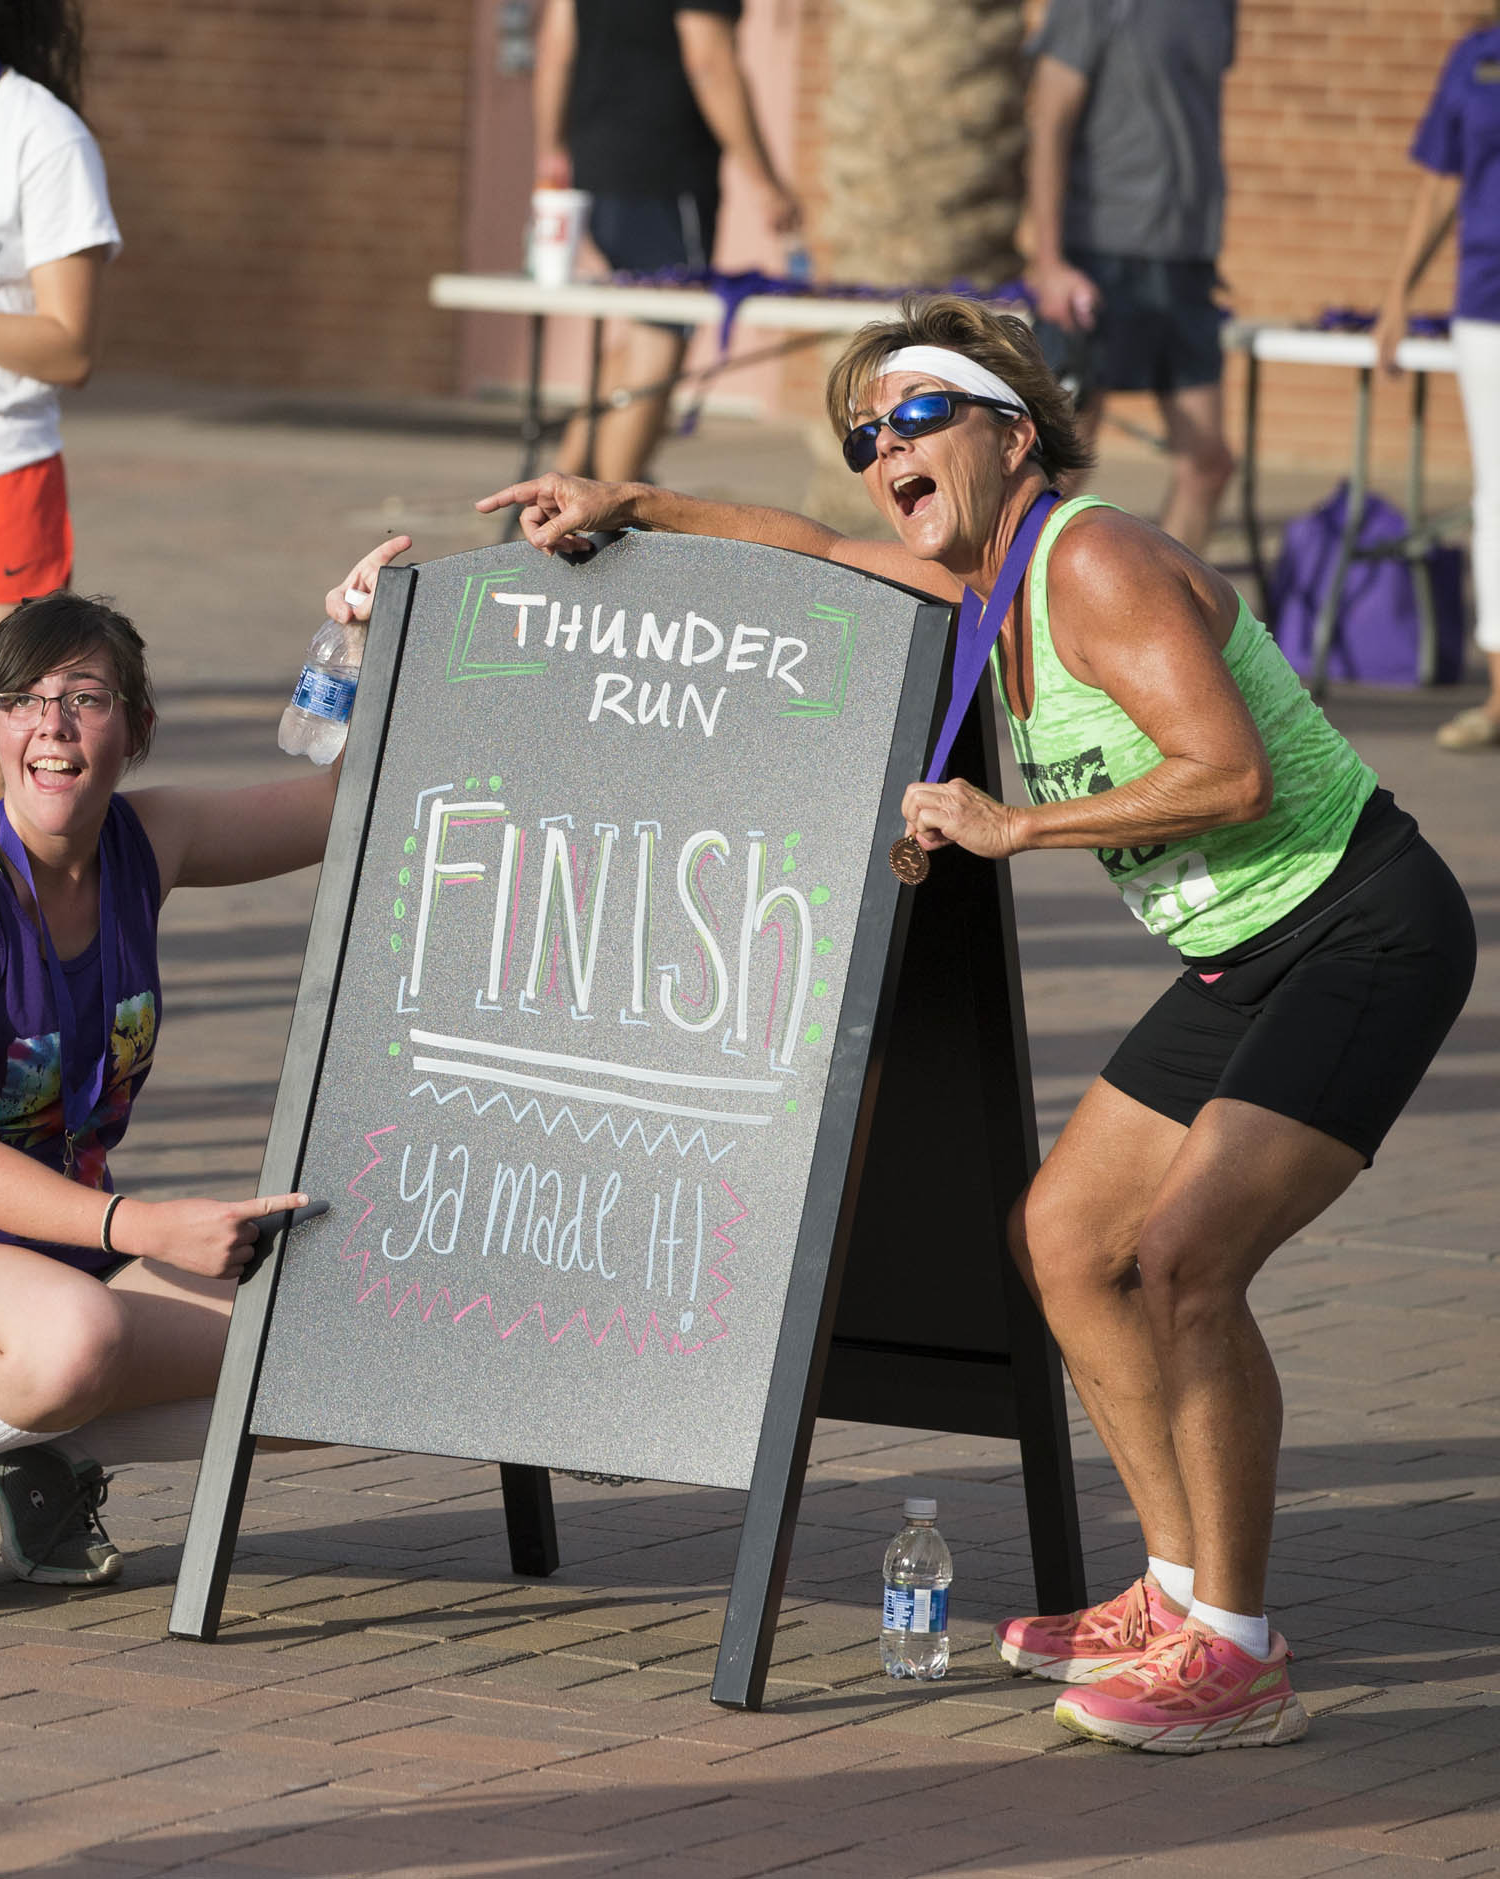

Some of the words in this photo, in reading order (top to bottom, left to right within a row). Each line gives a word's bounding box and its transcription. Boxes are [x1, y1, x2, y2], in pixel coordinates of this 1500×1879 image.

[491, 592, 809, 696] THUNDER
[587, 672, 728, 739] RUN
[381, 1143, 470, 1261] ya
[481, 1161, 622, 1281] made
